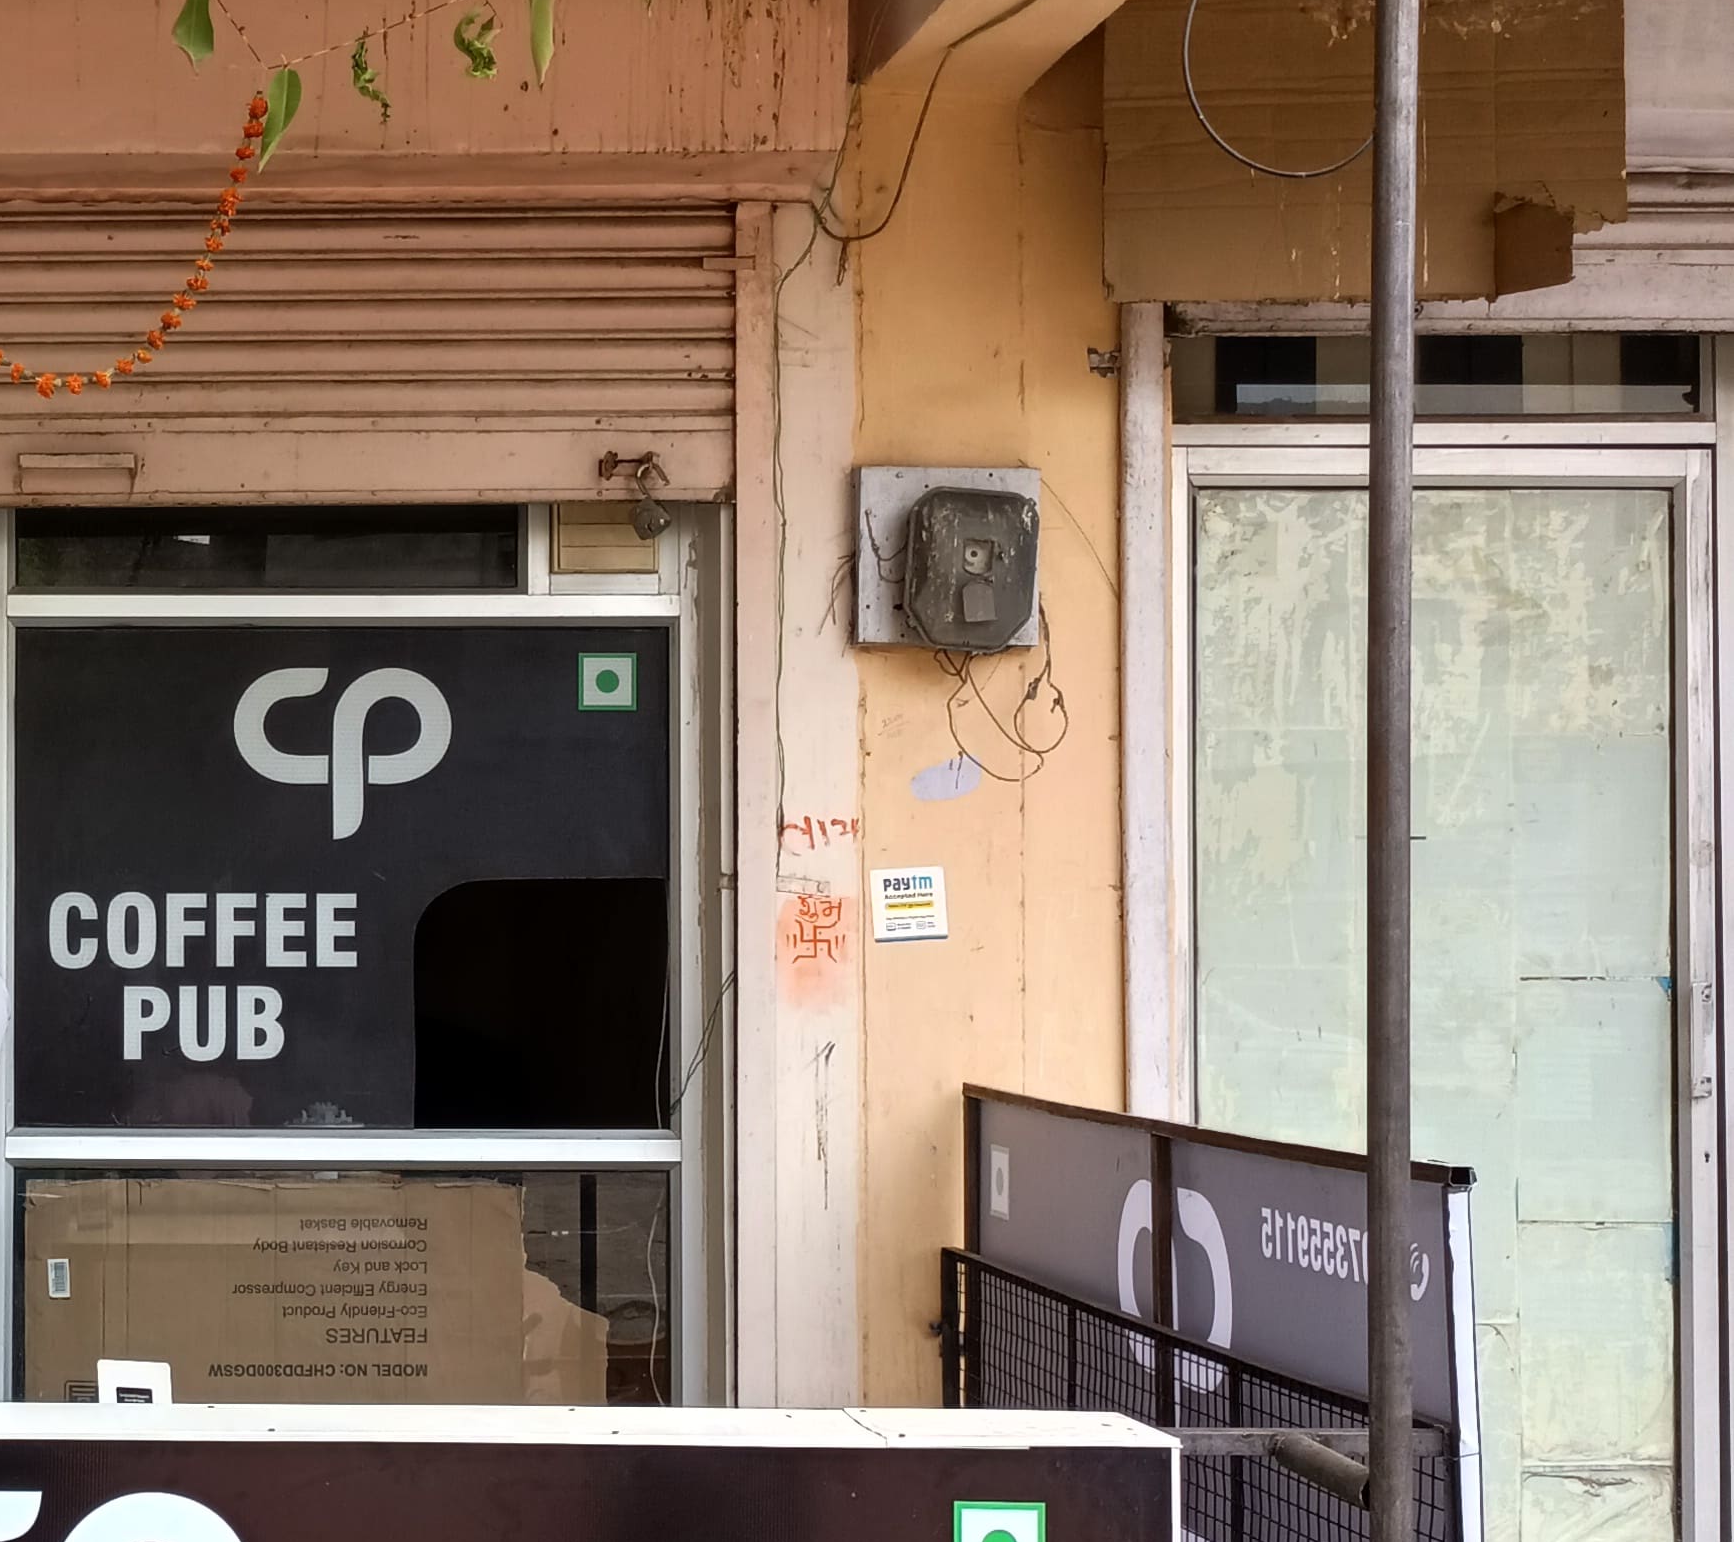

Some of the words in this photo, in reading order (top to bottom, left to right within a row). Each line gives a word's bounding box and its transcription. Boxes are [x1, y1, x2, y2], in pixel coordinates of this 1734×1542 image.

[49, 892, 357, 969] COFFEE
[123, 985, 285, 1062] PUB
[300, 1218, 346, 1231] Basket
[351, 1218, 427, 1231] Removable
[253, 1238, 288, 1253] Body
[293, 1241, 356, 1253] Resistant
[361, 1240, 427, 1252] Corrosion
[334, 1259, 359, 1274] Key
[365, 1261, 390, 1274] and
[395, 1261, 427, 1274] Lock
[233, 1282, 316, 1296] Compressor
[321, 1284, 374, 1296] Efficient
[379, 1281, 427, 1296] Energy
[282, 1306, 335, 1319] Product
[341, 1303, 427, 1319] Eco-Friendly
[326, 1328, 427, 1343] FEATURES
[340, 1364, 367, 1376] NO:
[372, 1364, 427, 1376] MODEL
